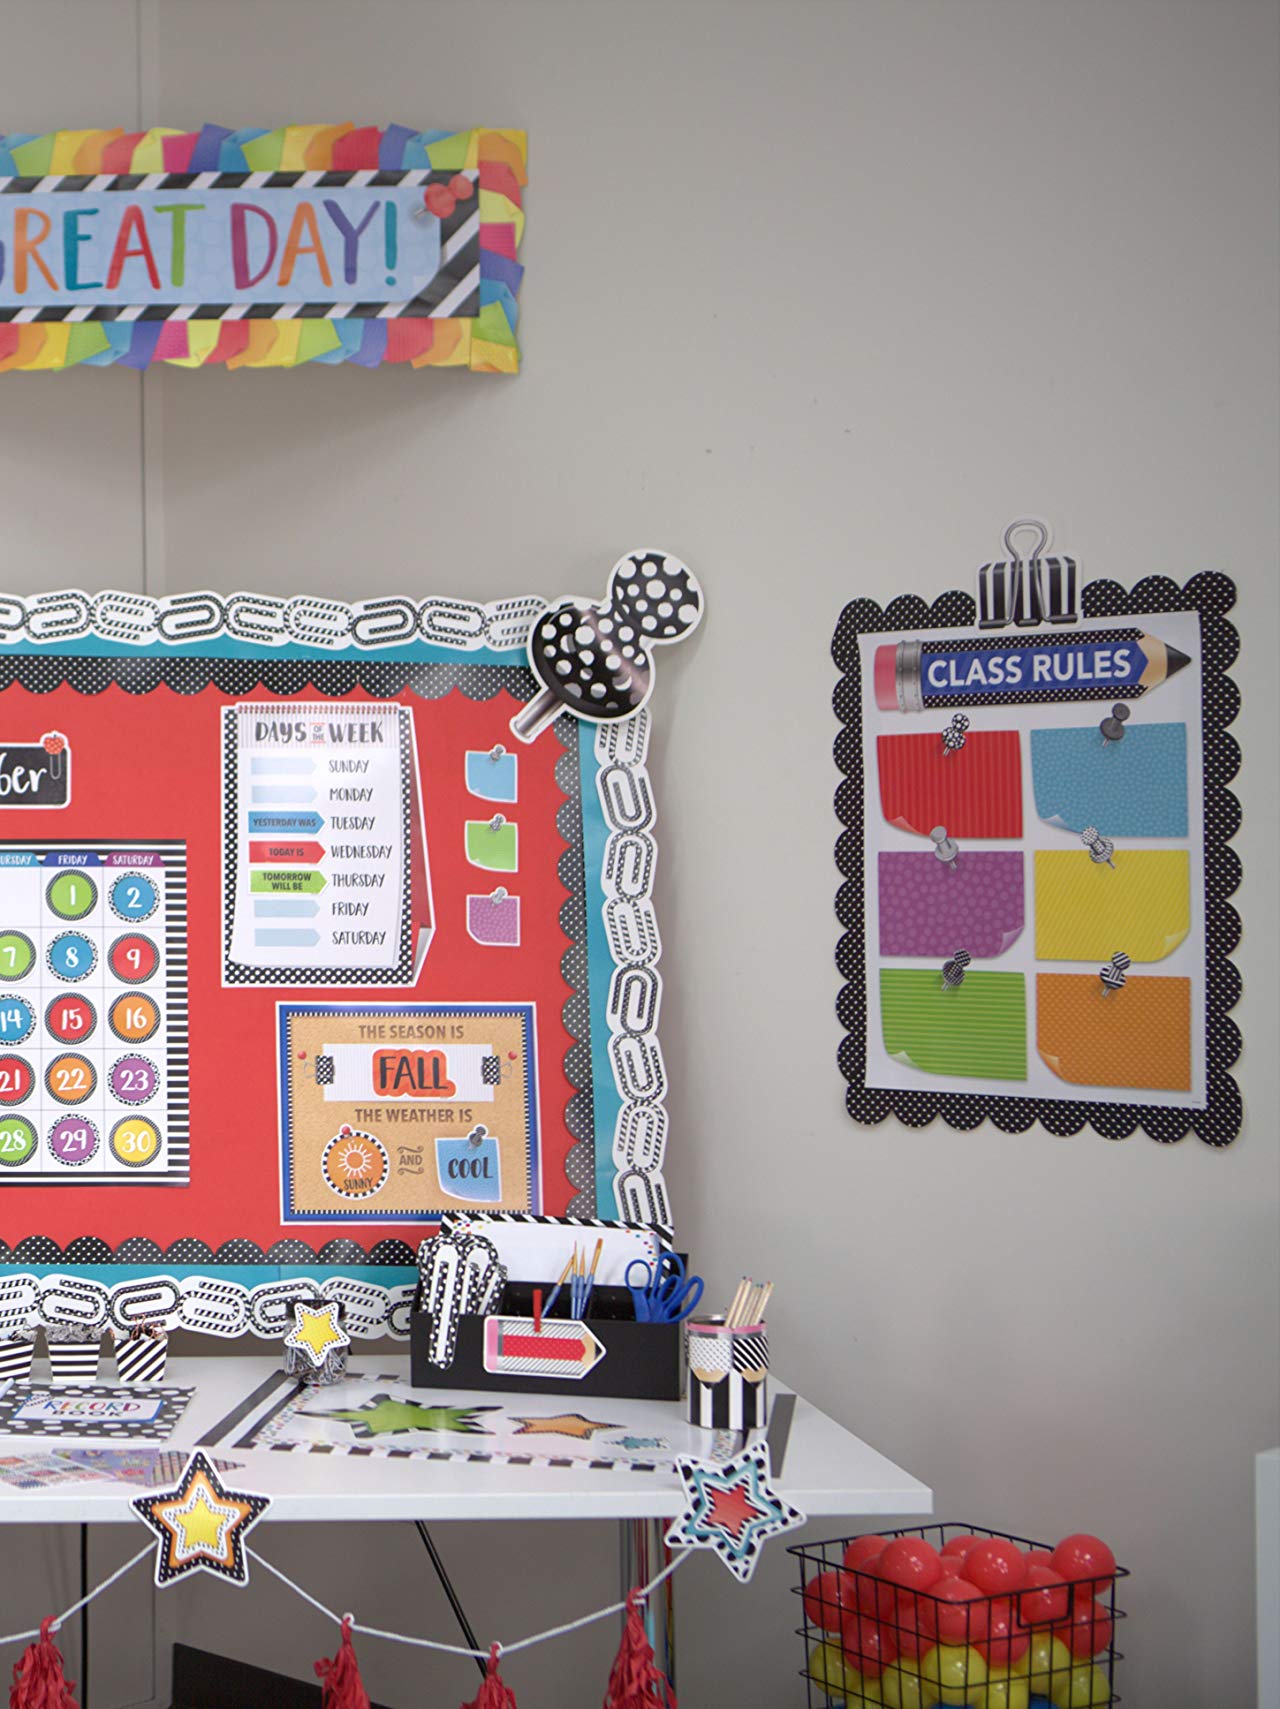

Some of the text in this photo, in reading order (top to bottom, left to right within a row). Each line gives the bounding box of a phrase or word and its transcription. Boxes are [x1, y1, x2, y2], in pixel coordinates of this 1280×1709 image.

[230, 199, 398, 291] DAY!
[926, 649, 1131, 688] CLASS RULES
[255, 720, 308, 744] DAYS
[312, 732, 325, 741] THE
[313, 725, 323, 733] OF
[328, 720, 384, 743] WEEK
[328, 759, 370, 773] SUNDAY
[329, 788, 374, 802] MONDAY
[253, 817, 317, 828] YESTERDAY WAS
[330, 816, 376, 831] TUESDAY
[268, 847, 305, 858] TODAY IS
[331, 845, 393, 860] WEDNESDAY
[57, 855, 88, 866] FRIDAY
[111, 855, 154, 866] SATURDAY
[262, 872, 312, 882] TOMORROW
[330, 873, 386, 888] THURSDAY
[271, 882, 303, 891] WILL BE
[70, 884, 76, 906] 1
[126, 886, 143, 908] 2
[331, 902, 370, 917] FRIDAY
[332, 930, 387, 946] SATURDAY
[2, 946, 17, 967] 7
[65, 946, 79, 968] 8
[126, 948, 140, 970] 9
[0, 1008, 24, 1033] 14
[61, 1008, 83, 1031] 15
[126, 1006, 147, 1030] 16
[358, 1024, 465, 1039] THE SEASON IS
[56, 1068, 88, 1091] 22
[120, 1069, 149, 1091] 23
[380, 1055, 450, 1090] FALL
[355, 1109, 473, 1123] THE WEATHER IS
[60, 1128, 88, 1153] 29
[121, 1131, 151, 1153] 30
[398, 1154, 424, 1167] AND
[447, 1155, 494, 1180] COOL
[343, 1177, 374, 1192] SUNNY
[43, 1399, 141, 1411] RECORD
